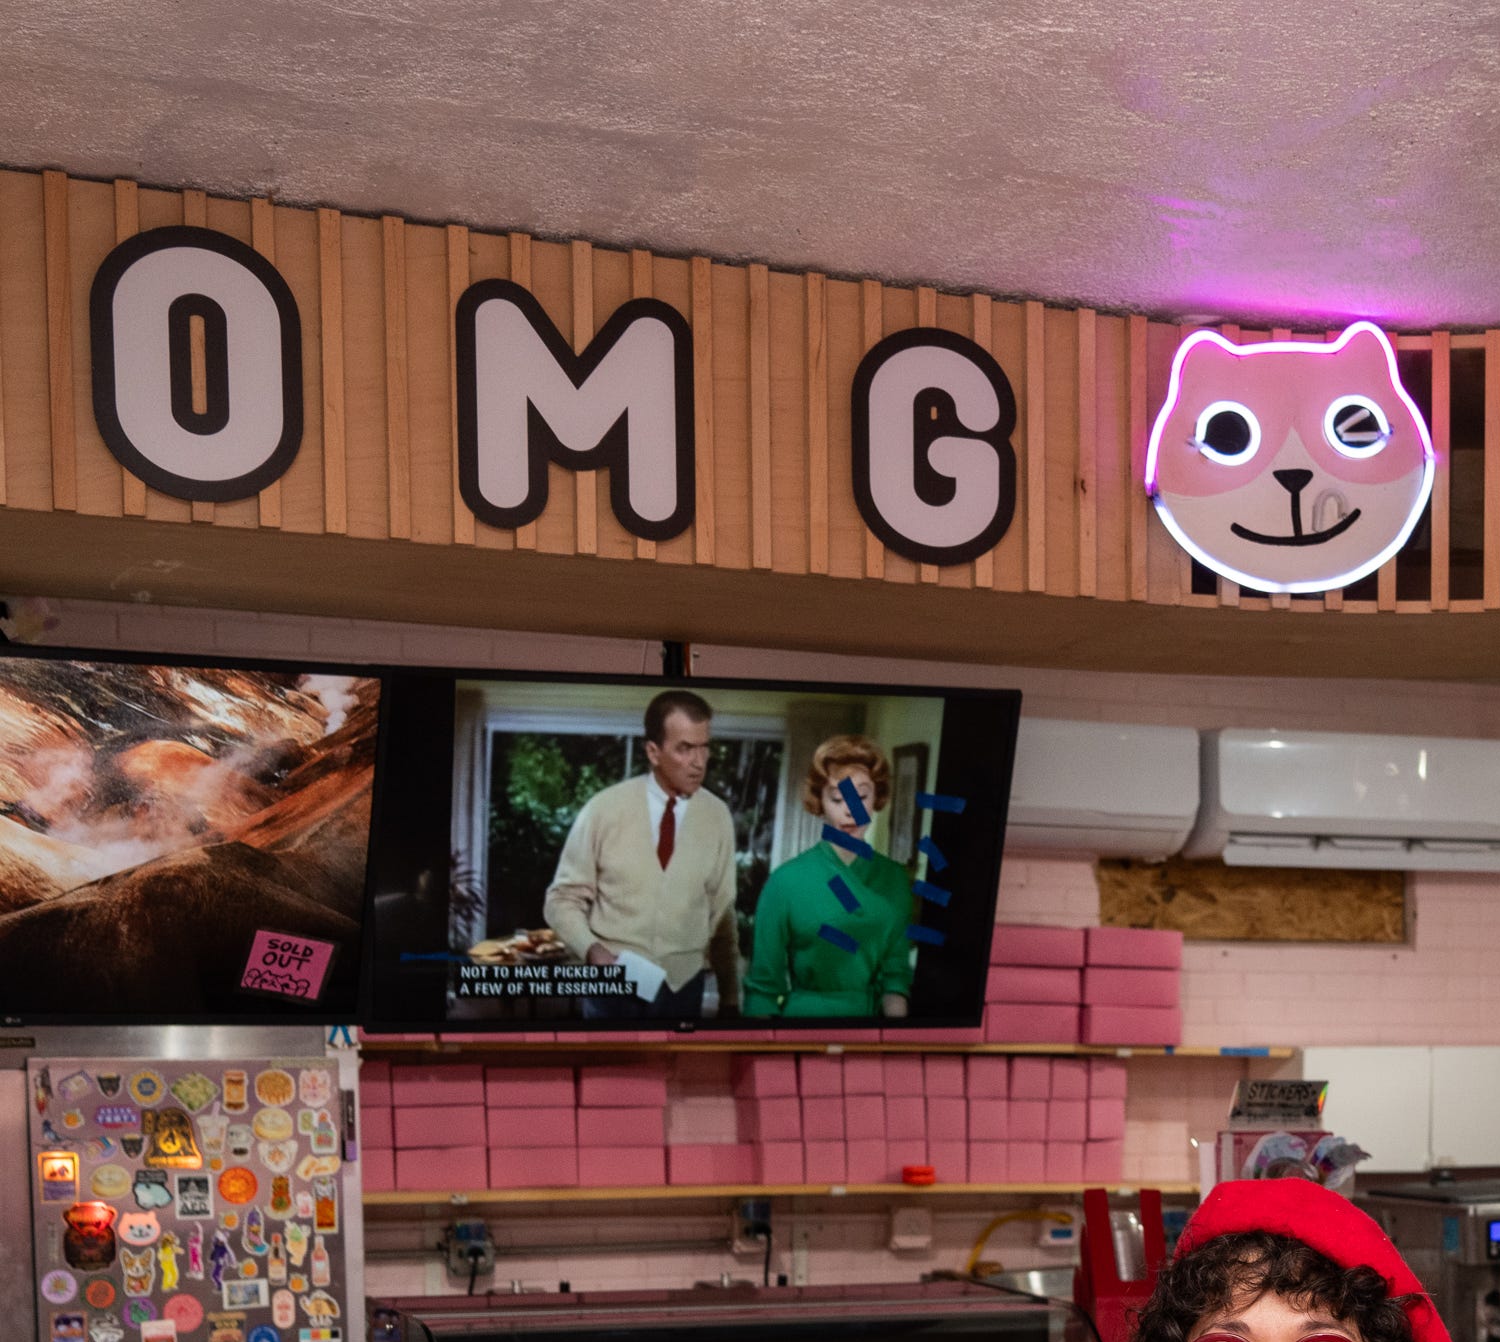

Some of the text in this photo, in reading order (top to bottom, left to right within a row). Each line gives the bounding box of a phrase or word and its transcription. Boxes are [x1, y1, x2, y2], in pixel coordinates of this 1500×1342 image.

[92, 226, 1016, 564] OMG
[268, 939, 313, 957] SOLD
[262, 951, 311, 971] OUT
[461, 966, 621, 978] NOT TO HAVE PICKED UP
[460, 982, 633, 995] A FEW OF THE ESSENTIALS
